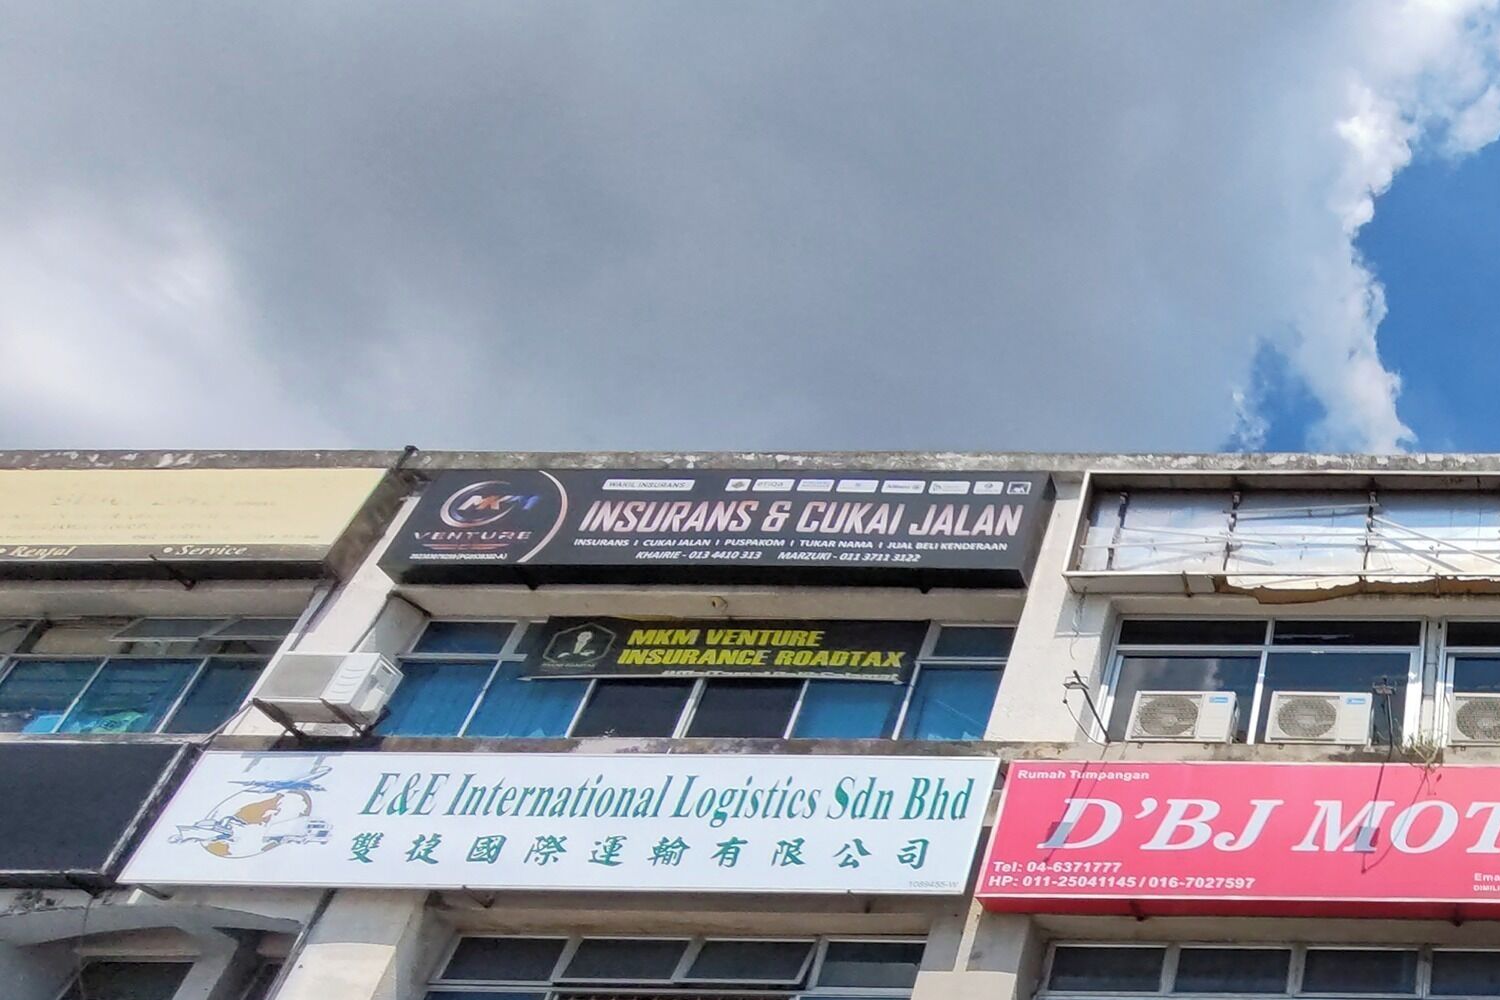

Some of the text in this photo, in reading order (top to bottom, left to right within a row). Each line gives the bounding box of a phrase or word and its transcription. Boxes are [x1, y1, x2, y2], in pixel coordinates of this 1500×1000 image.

[578, 500, 1024, 536] INSURANS & CUKAI JALAN
[413, 531, 533, 541] VENTURE
[176, 544, 248, 556] Service
[573, 538, 1008, 551] INSURANS CUKAI JALAN PUSPAKOM TUKAR NAMA JUAL BELI KENDERAAN
[9, 545, 77, 559] Rental
[635, 551, 681, 560] KHAIRIE
[689, 551, 712, 560] 013
[777, 551, 832, 561] MARZUKI
[839, 552, 861, 561] 011
[627, 629, 825, 648] MKM VENTURE
[617, 648, 772, 667] INSURANCE
[774, 650, 905, 668] ROADTAX
[1017, 769, 1150, 781] Rumah Tumpangan
[359, 771, 976, 829] E&E International Logistics Sdn Bhd
[1035, 797, 1285, 852] D'BJ
[347, 831, 932, 872] 雙捷國際運輸有限公司
[992, 861, 1123, 874] Tel: 04-6371777
[988, 875, 1256, 890] HP: 011-25041145 016-7027597
